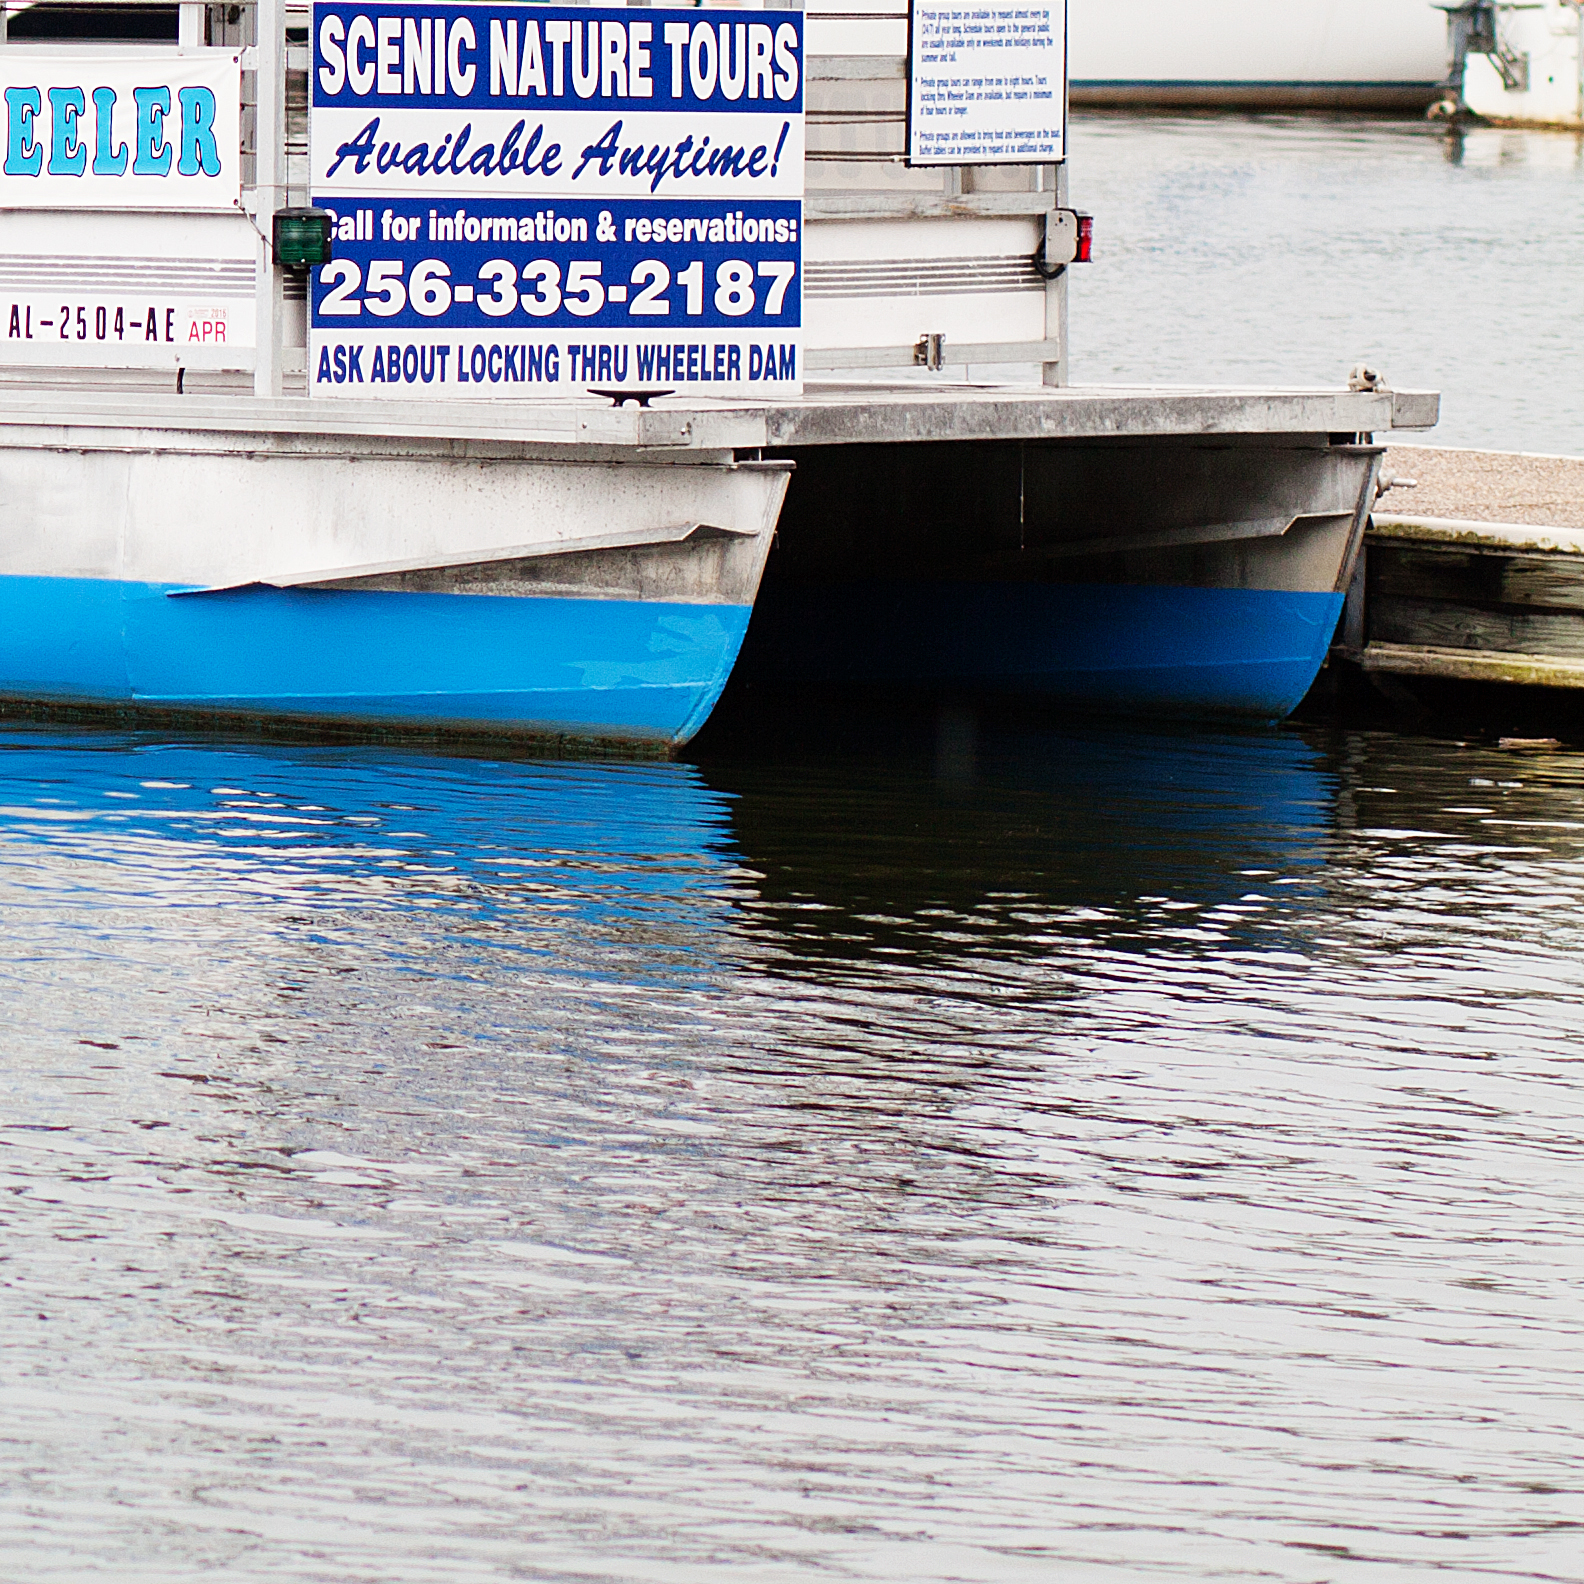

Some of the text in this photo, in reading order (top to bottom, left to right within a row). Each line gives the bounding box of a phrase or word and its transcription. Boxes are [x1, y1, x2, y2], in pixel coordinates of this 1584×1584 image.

[318, 14, 799, 101] SCENIC NATURE TOURS
[327, 117, 791, 193] Available Anytime!
[380, 209, 421, 241] for
[428, 209, 588, 242] information
[595, 210, 617, 242] &
[624, 210, 797, 243] reservations:
[319, 258, 795, 317] 256-335-2187
[8, 304, 175, 343] AL-2504-AE
[188, 321, 226, 342] APR
[317, 344, 796, 384] ASK ABOUT LOCKING THRU WHEELER DAM
